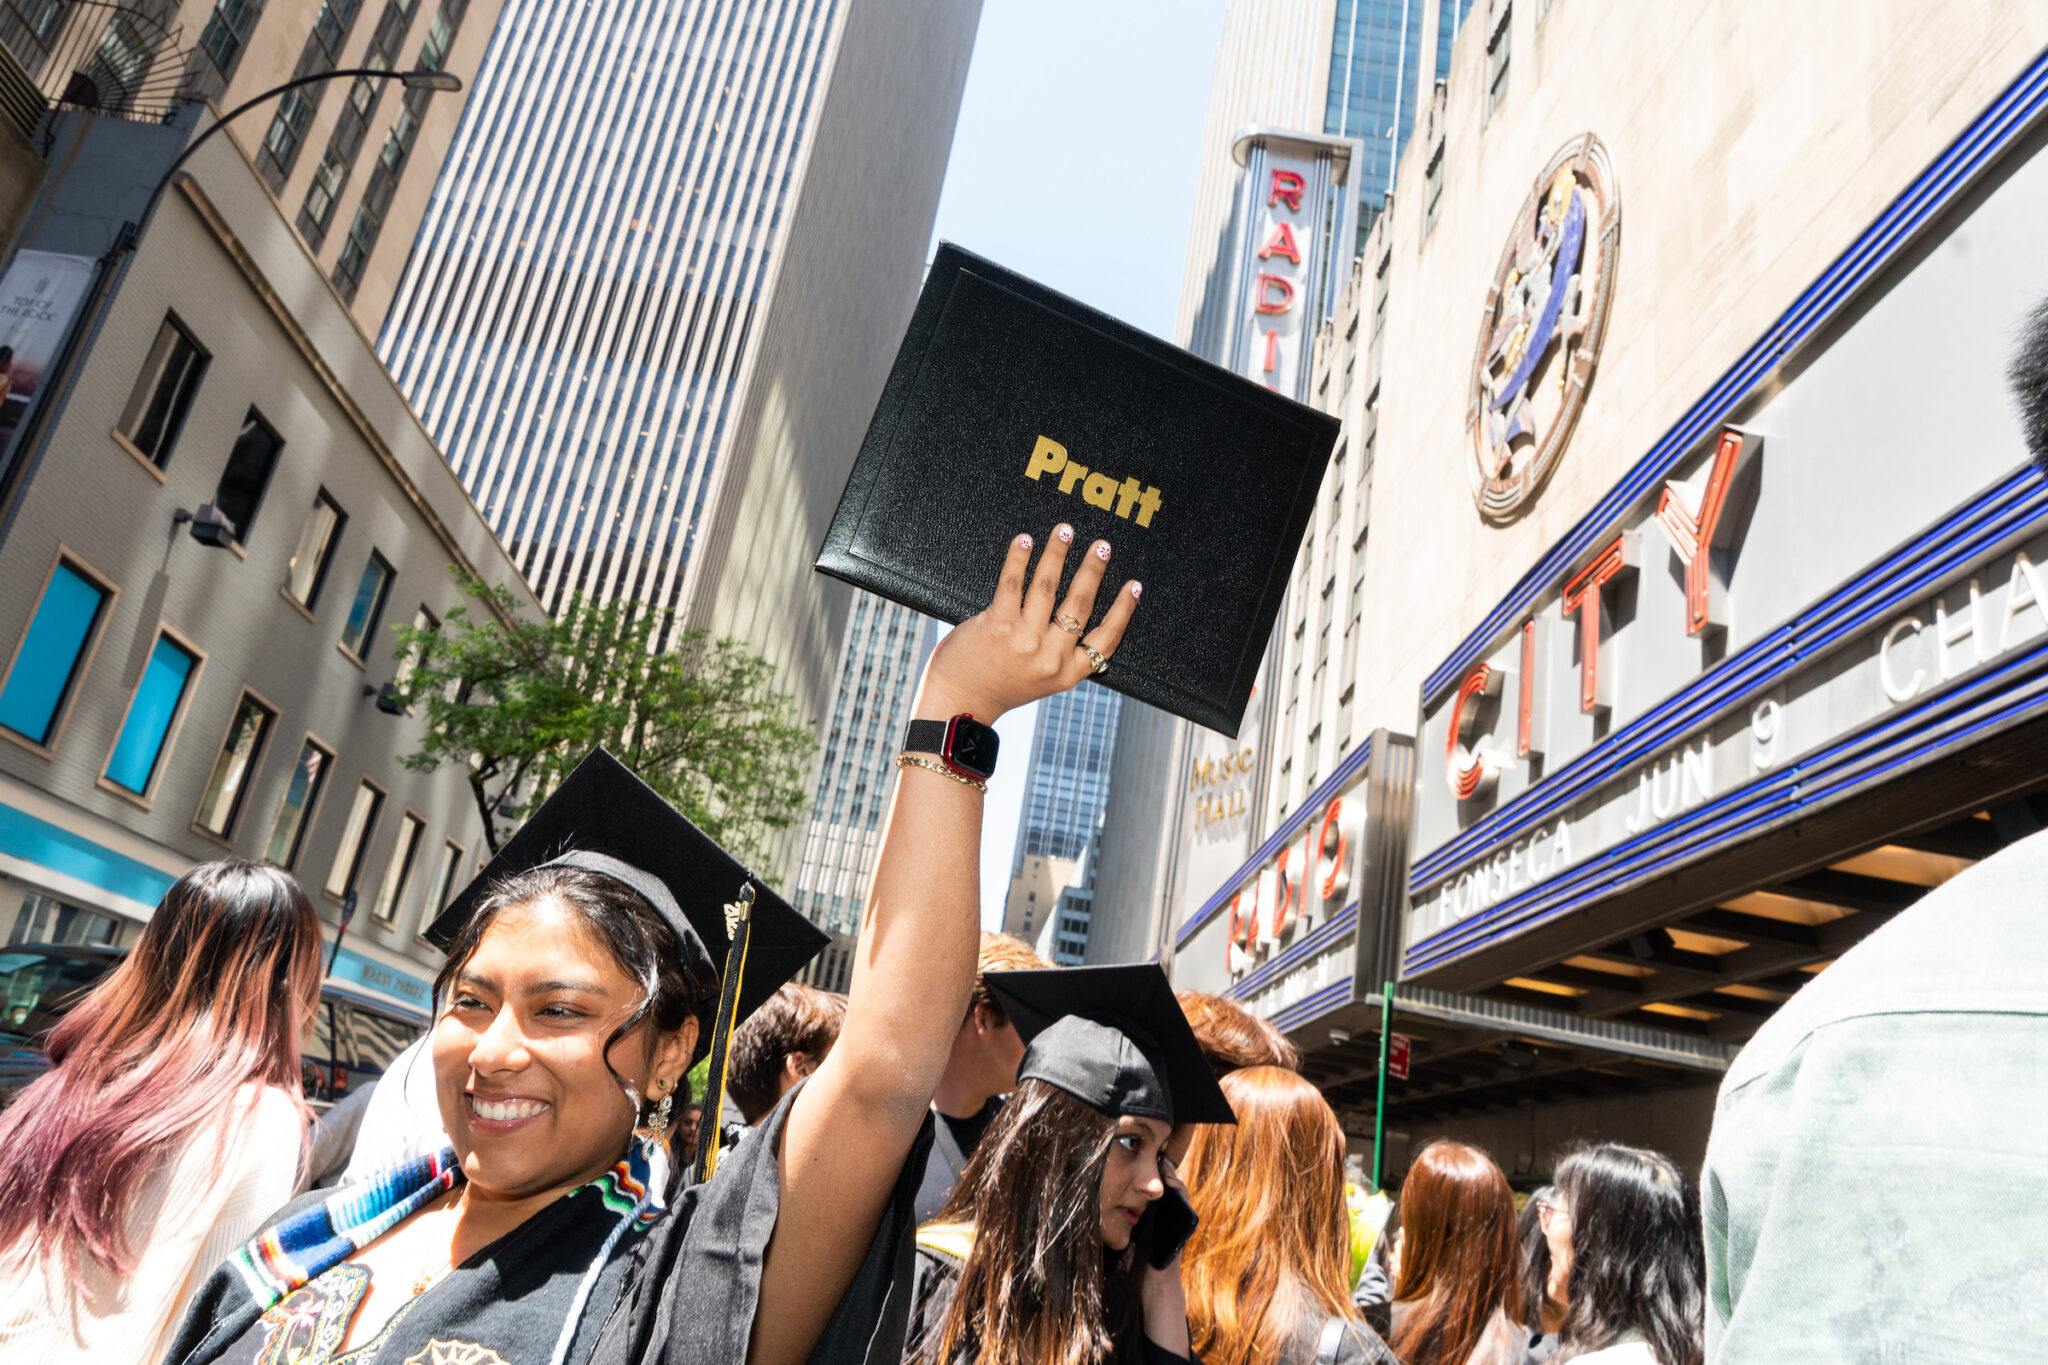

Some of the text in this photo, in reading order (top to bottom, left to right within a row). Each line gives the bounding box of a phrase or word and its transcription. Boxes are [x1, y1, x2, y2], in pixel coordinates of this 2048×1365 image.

[1256, 168, 1306, 393] RADI
[1024, 434, 1163, 529] Pratt
[1446, 424, 1745, 800] CITY
[1191, 747, 1253, 792] MUSIC
[1195, 788, 1247, 830] HALL
[1438, 815, 1573, 928] FONSECA
[1625, 732, 1712, 833] JUN
[1752, 698, 1781, 769] 9
